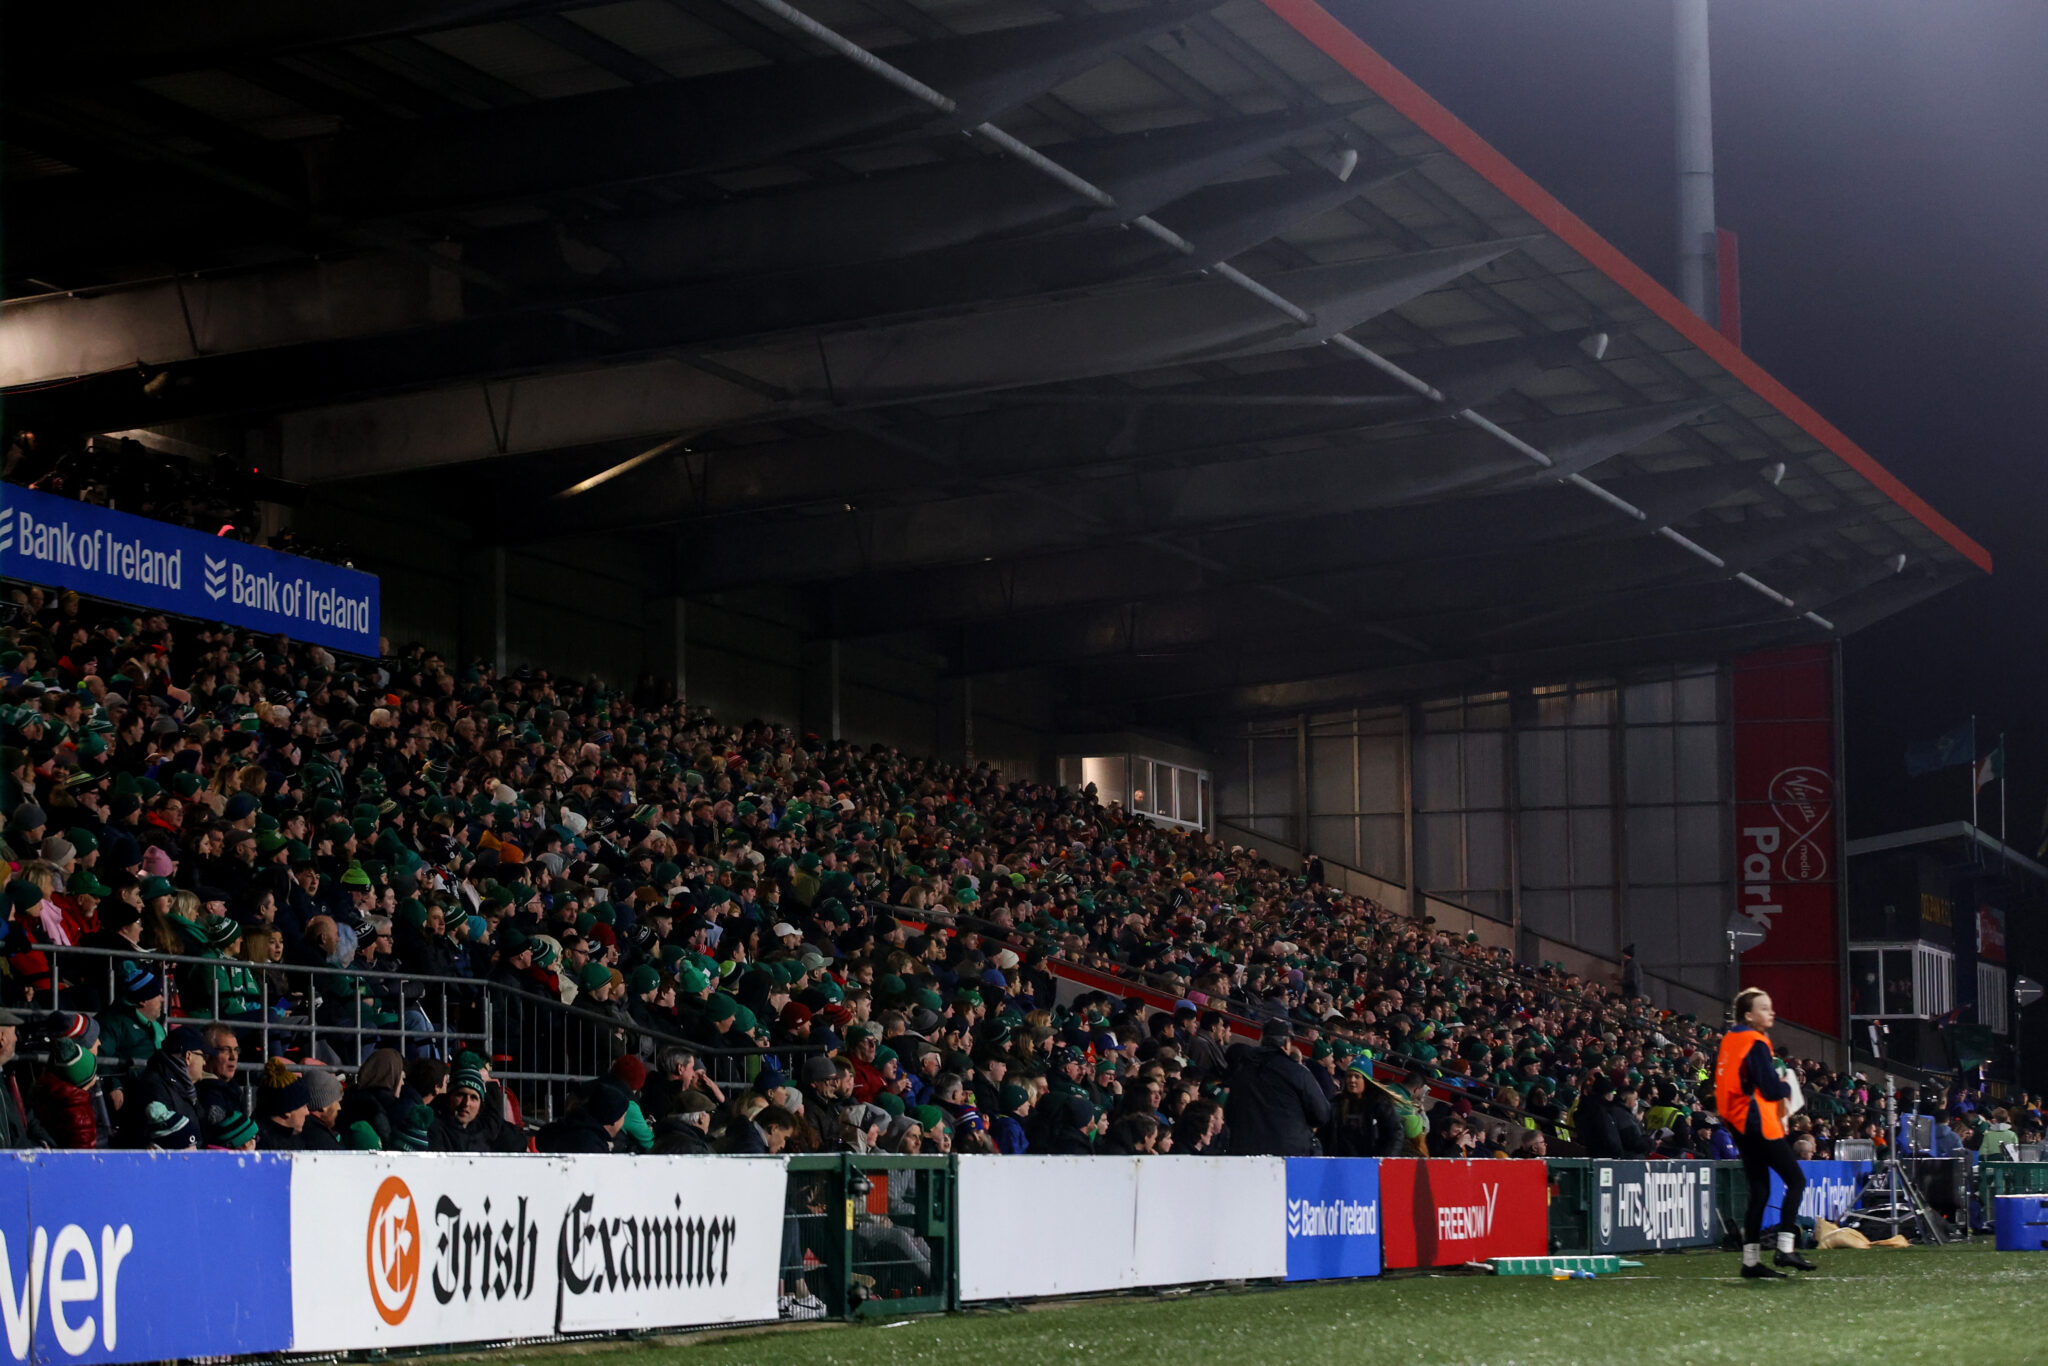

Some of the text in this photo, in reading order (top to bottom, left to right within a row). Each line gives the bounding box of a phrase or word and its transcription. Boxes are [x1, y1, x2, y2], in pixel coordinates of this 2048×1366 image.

[20, 511, 181, 589] Bank of Ireland
[232, 563, 369, 634] Bank of Ireland
[1782, 775, 1824, 822] Virgin
[1743, 826, 1783, 930] Park
[1301, 1200, 1376, 1236] Bank of Ireland
[1618, 1168, 1697, 1243] HITS DIFFERENT
[432, 1190, 736, 1305] Irish Examiner
